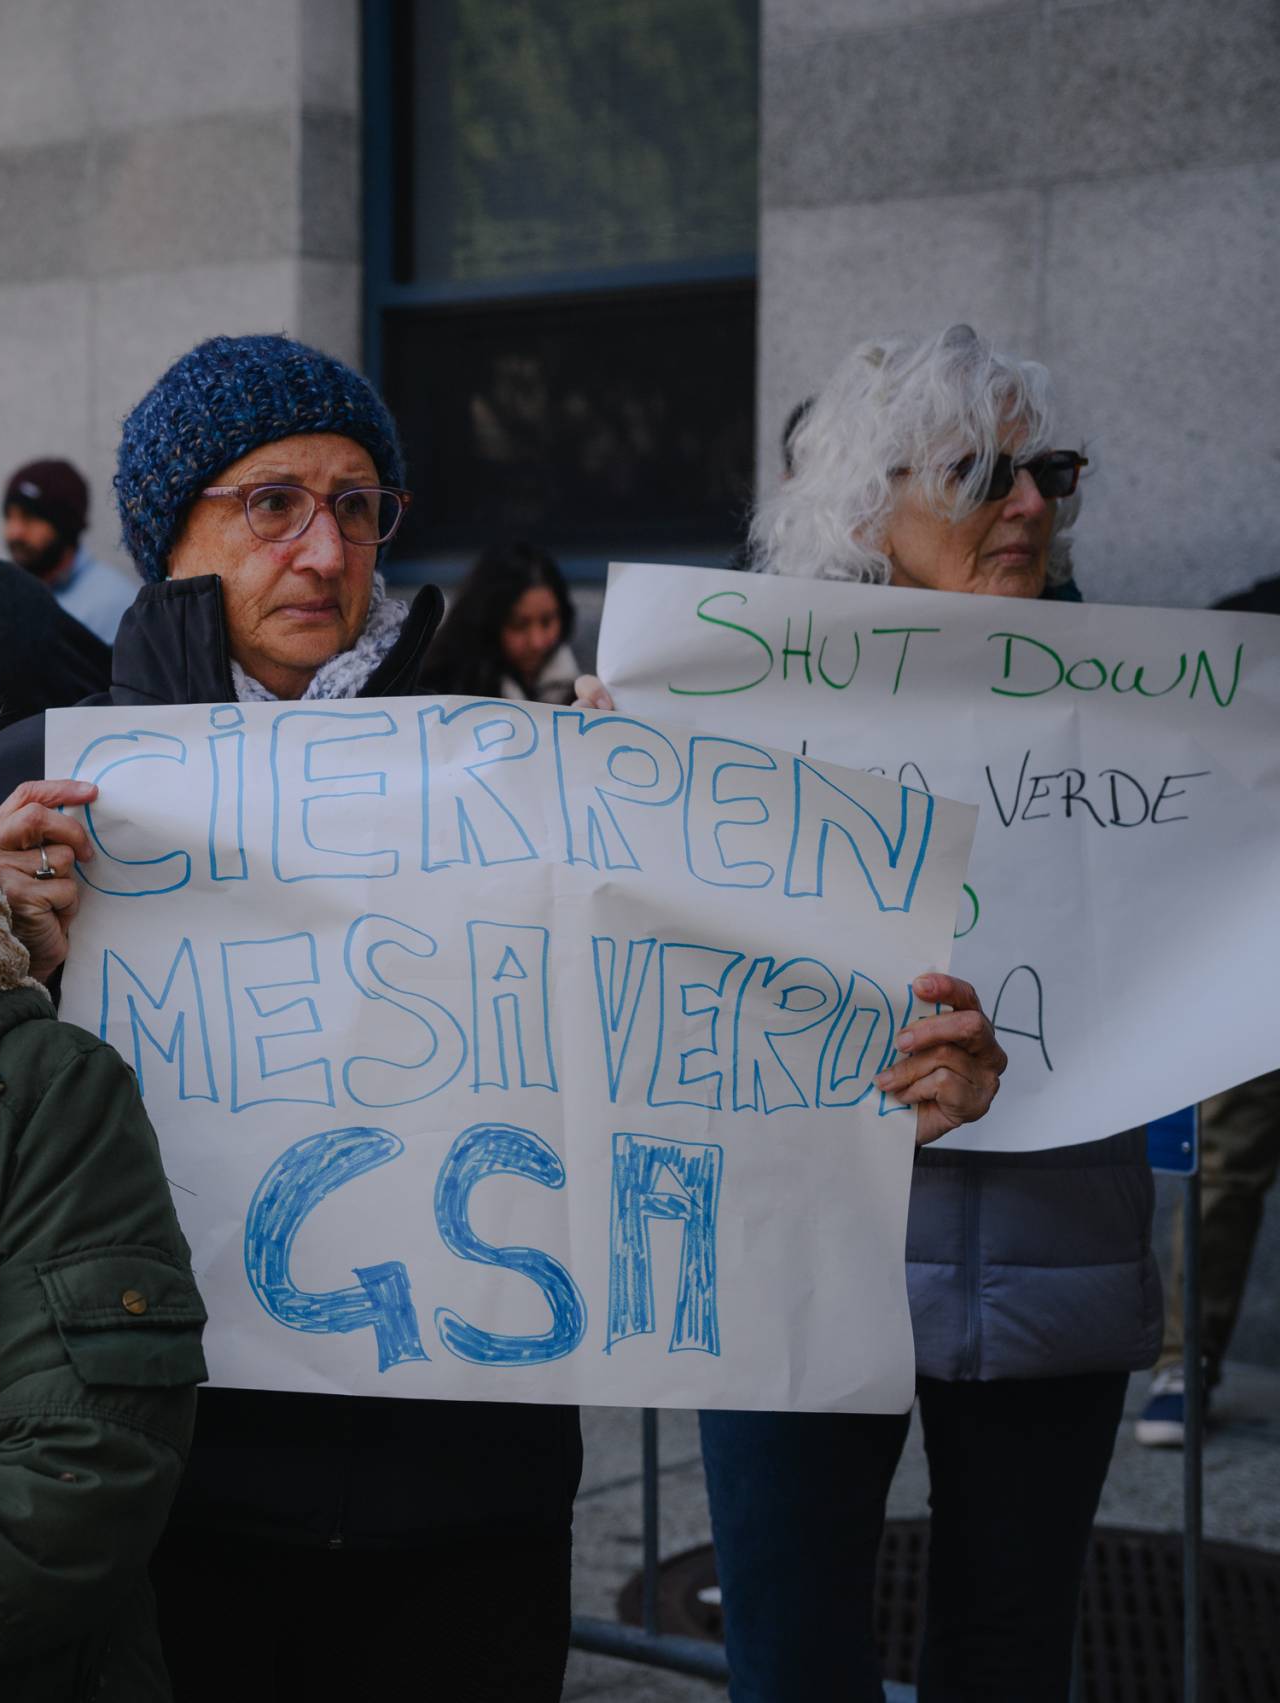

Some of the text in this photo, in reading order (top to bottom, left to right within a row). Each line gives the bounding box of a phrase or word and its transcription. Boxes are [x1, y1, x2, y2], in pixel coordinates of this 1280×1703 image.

[668, 591, 941, 697] SHUT
[984, 748, 1212, 828] VERDE
[99, 913, 560, 1114] MESA
[244, 1121, 724, 1374] GSA
